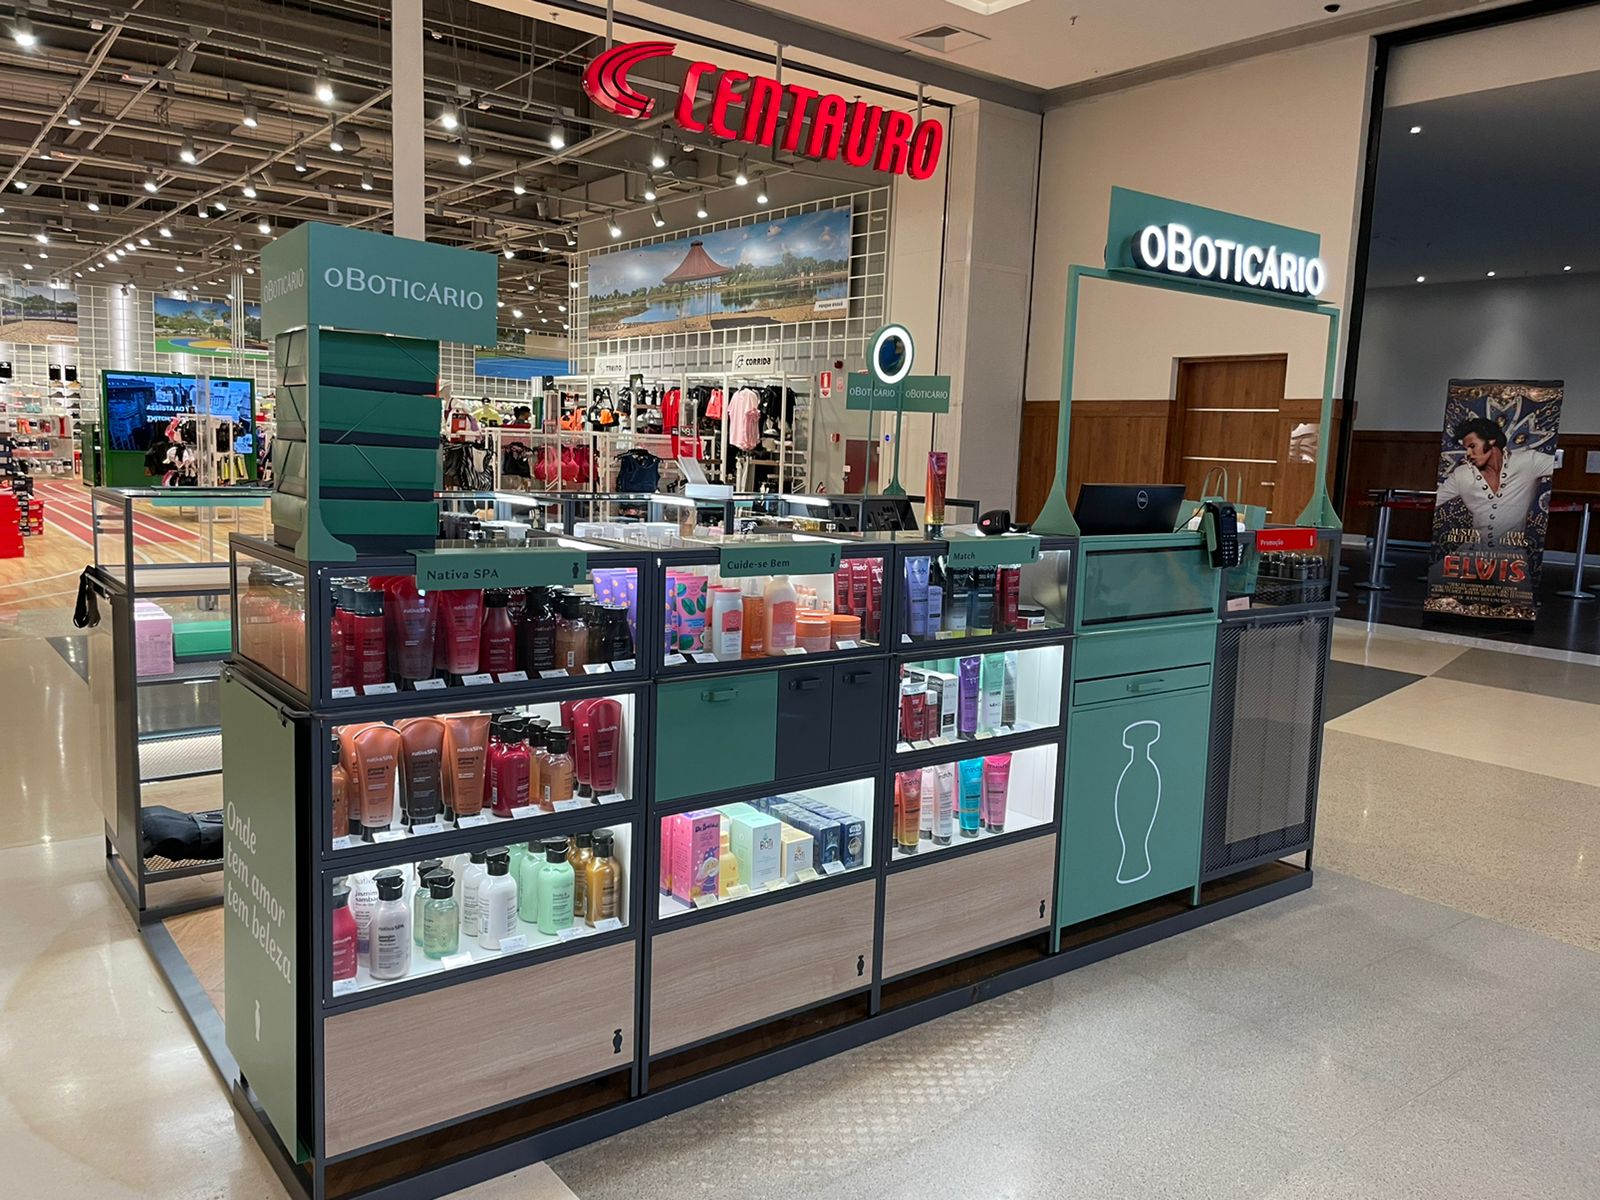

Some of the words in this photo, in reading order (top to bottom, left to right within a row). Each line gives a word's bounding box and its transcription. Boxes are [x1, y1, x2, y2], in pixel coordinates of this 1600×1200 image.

[674, 61, 943, 180] CENTAURO
[426, 568, 469, 580] Nativa
[473, 568, 499, 579] SPA
[727, 559, 768, 570] Cuide-se
[770, 558, 790, 568] Bem
[953, 551, 976, 560] Match
[1442, 555, 1528, 582] ELVIS
[226, 800, 258, 855] Onde
[226, 840, 249, 888] tem
[251, 872, 287, 928] amor
[226, 879, 250, 928] tem
[251, 904, 292, 984] beleza
